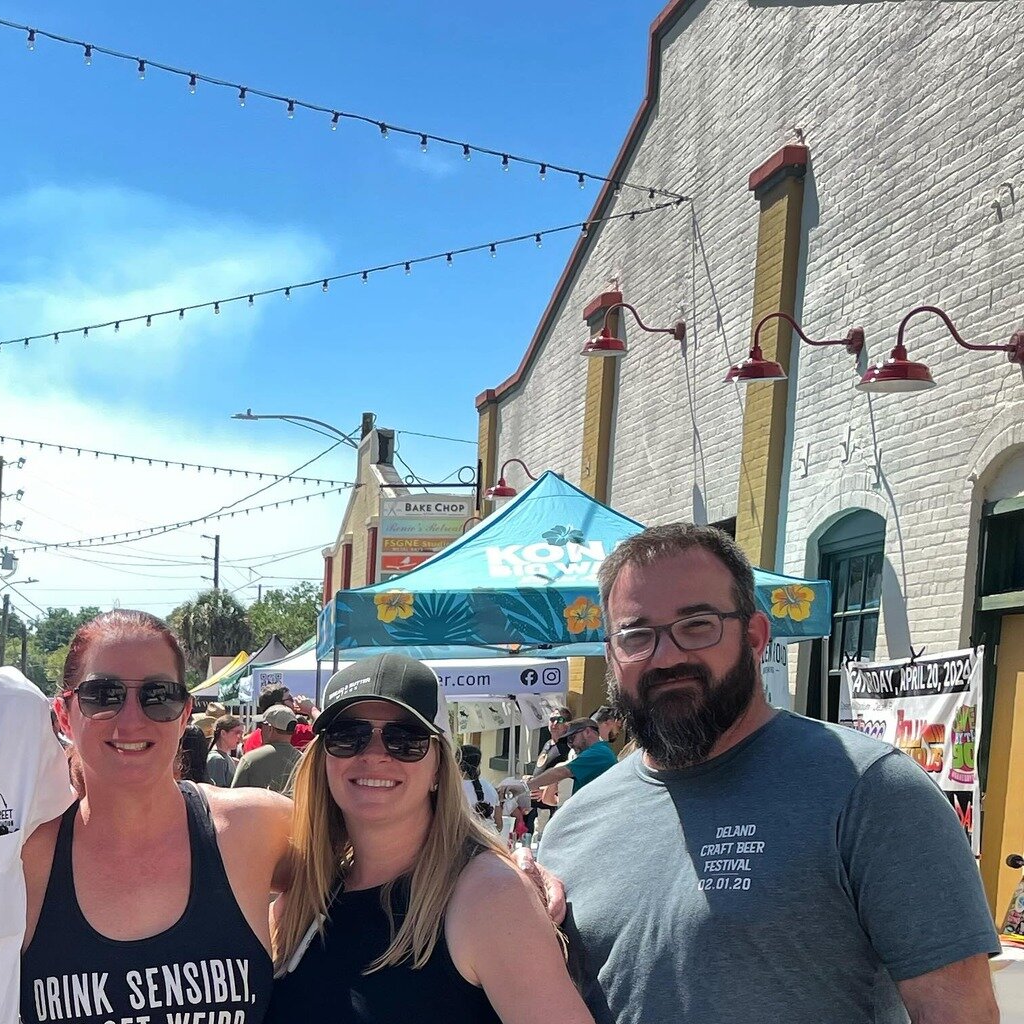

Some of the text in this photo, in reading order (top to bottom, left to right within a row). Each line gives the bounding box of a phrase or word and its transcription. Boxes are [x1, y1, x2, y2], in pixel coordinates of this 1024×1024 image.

[405, 502, 465, 512] BAKE CHOP
[485, 540, 610, 563] KON
[899, 664, 926, 692] APRIL
[716, 824, 756, 839] DELAND
[700, 841, 765, 857] CRAFT BEER
[704, 858, 752, 872] FESTIVAL
[697, 877, 751, 891] 02.01.20
[33, 958, 256, 1022] DRINK SENSIBLY,
